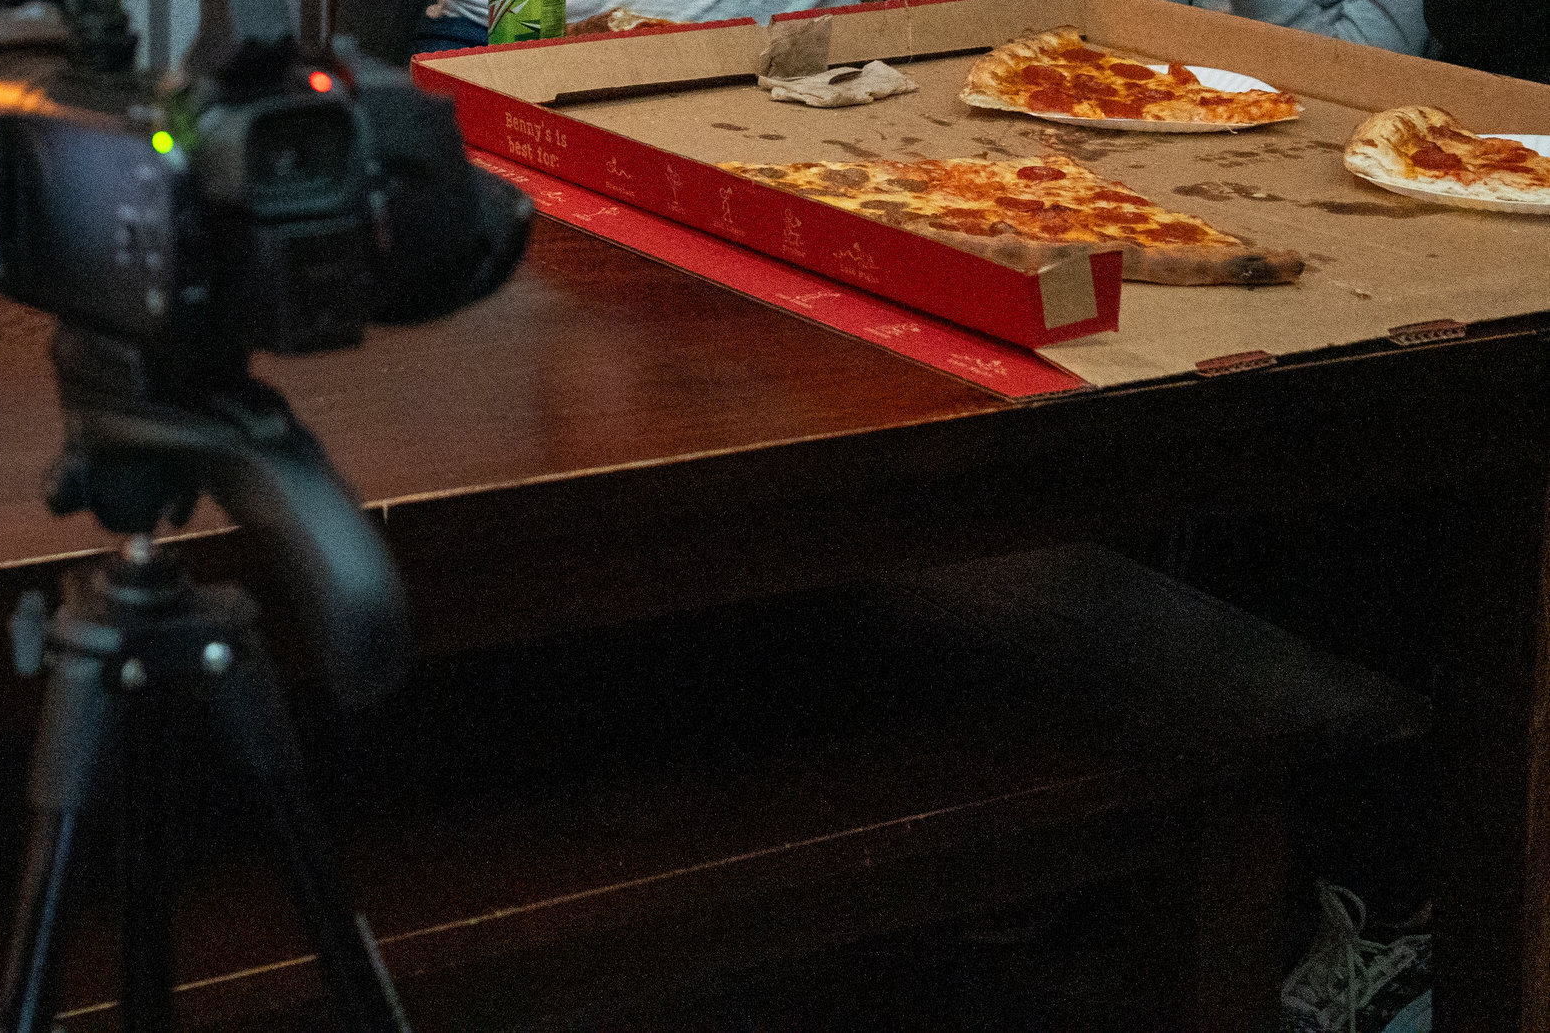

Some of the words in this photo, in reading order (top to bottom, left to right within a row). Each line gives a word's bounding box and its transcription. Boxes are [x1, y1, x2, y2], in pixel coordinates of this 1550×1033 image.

[505, 111, 552, 142] Benny's
[555, 129, 568, 148] is
[507, 135, 533, 161] best
[536, 146, 560, 168] for:
